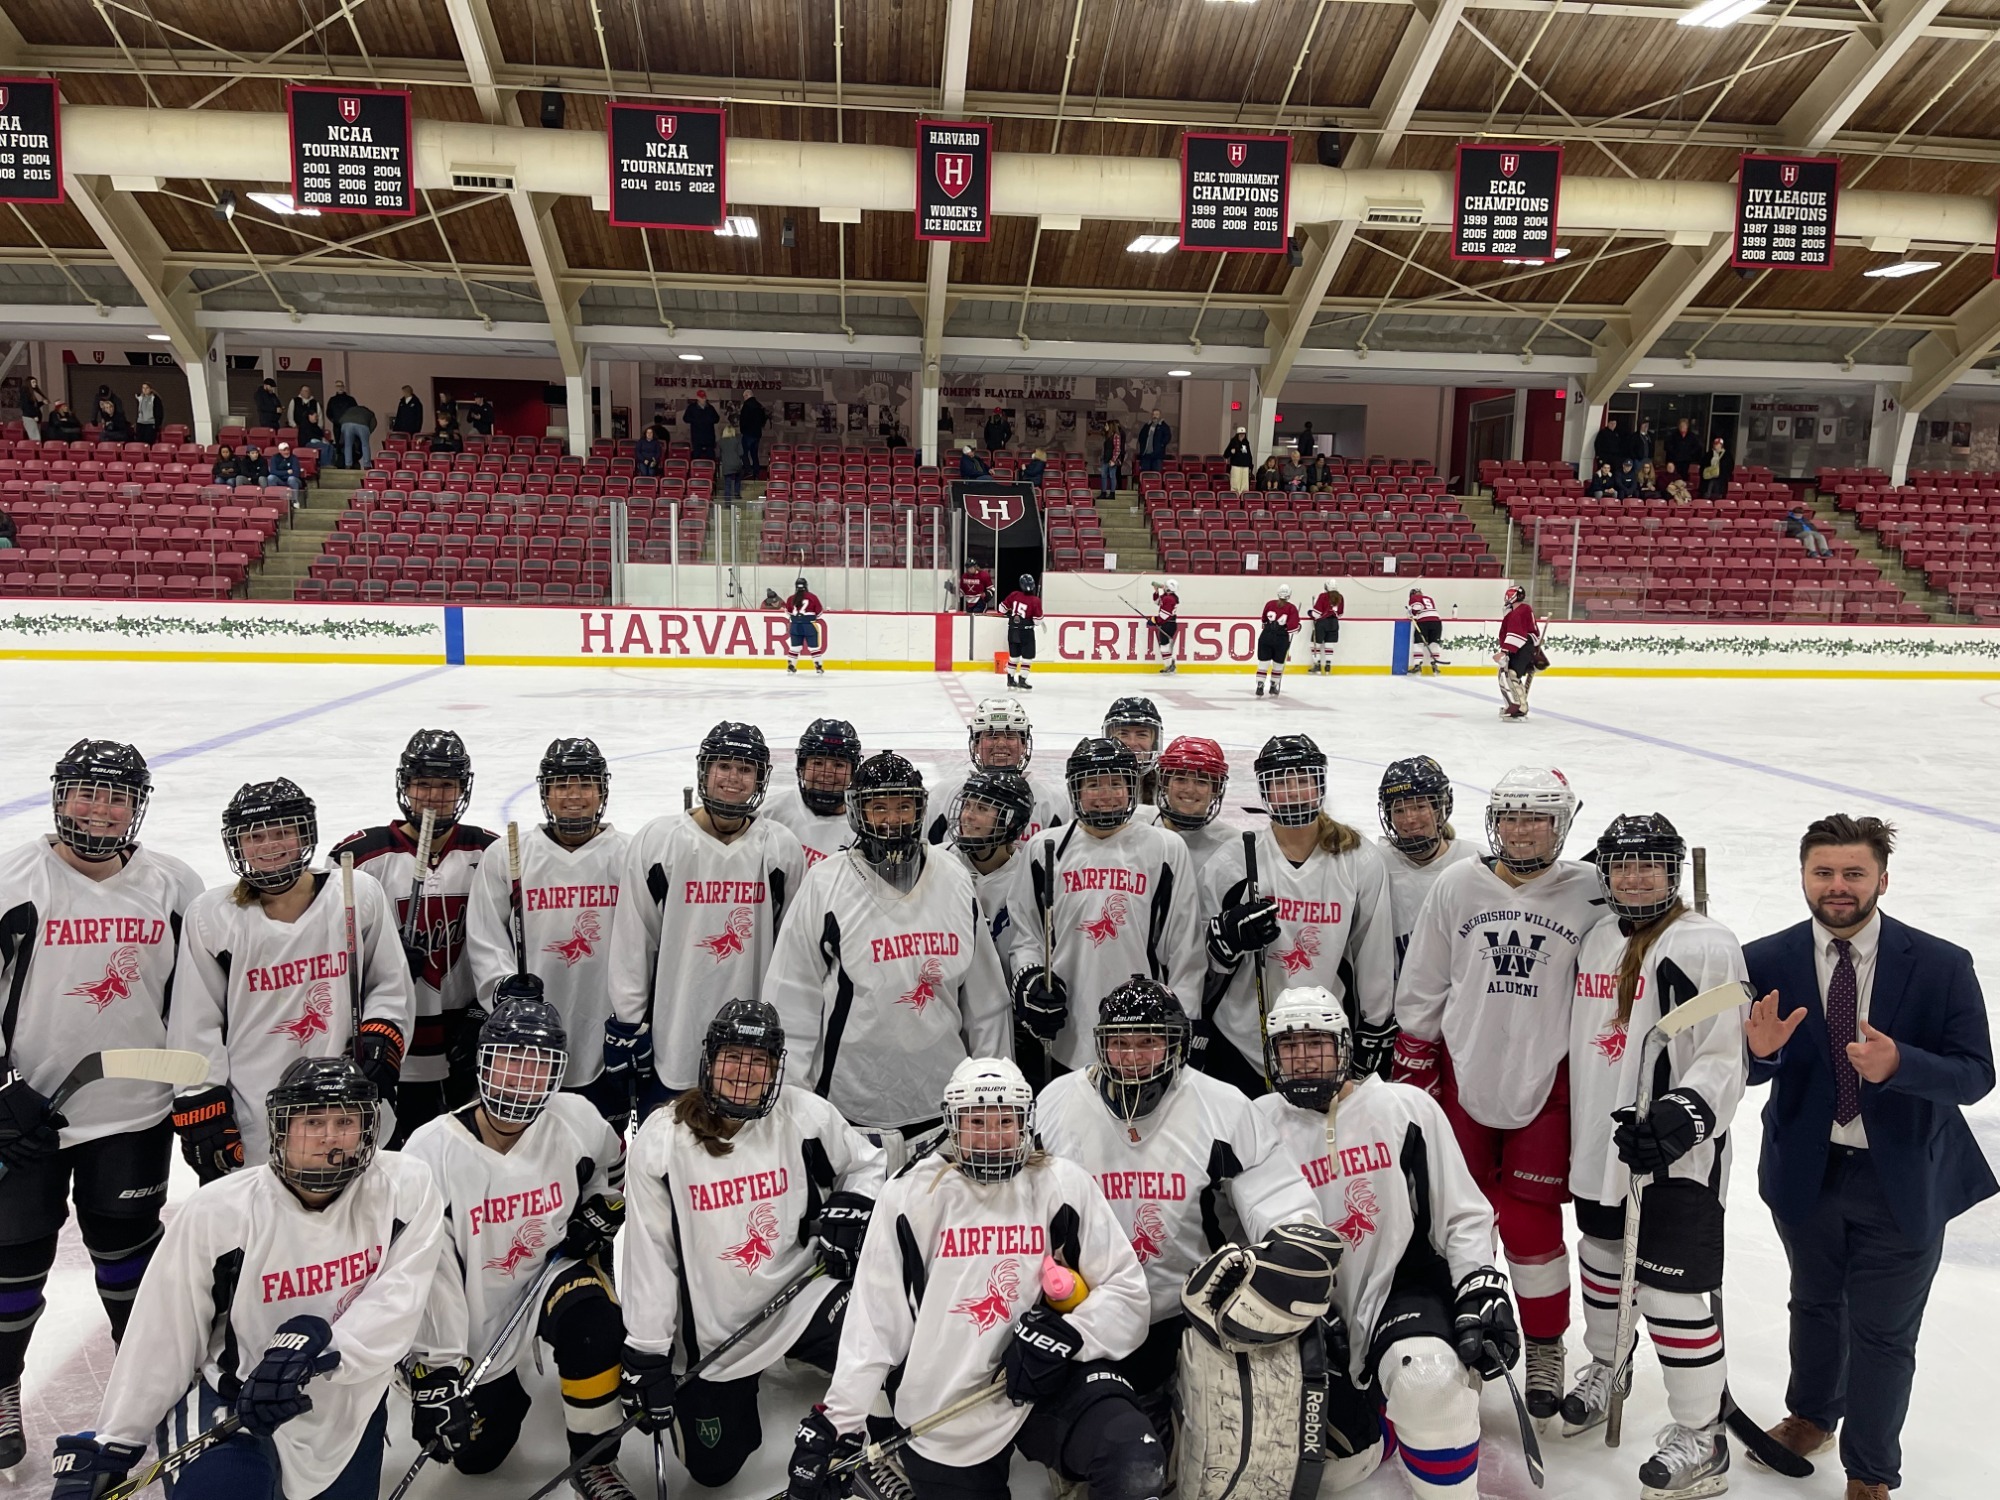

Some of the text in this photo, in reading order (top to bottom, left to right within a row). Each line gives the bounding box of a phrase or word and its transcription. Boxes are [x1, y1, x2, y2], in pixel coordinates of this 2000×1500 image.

[344, 100, 356, 116] H
[0, 116, 22, 131] AA
[661, 118, 672, 134] H
[11, 134, 49, 148] FOUR
[328, 126, 373, 142] NCAA
[930, 132, 980, 146] HARVARD
[302, 144, 400, 160] TOURNAMENT
[646, 142, 688, 159] NCAA
[1232, 146, 1242, 160] H
[0, 154, 51, 165] 03 2004
[1504, 156, 1515, 171] H
[0, 168, 52, 180] 08 2015
[303, 163, 401, 177] 2001 2003 2004
[621, 159, 714, 177] TOURNAMENT
[944, 158, 963, 185] H
[1784, 168, 1795, 182] H
[304, 178, 402, 192] 2005 2006 2007
[621, 178, 715, 193] 2014 2015 2022
[1194, 172, 1280, 185] ECAC TOURNAMENT
[1192, 186, 1279, 202] CHAMPIONS
[1490, 180, 1526, 195] ECAC
[304, 192, 402, 206] 2008 2010 2013
[1465, 196, 1550, 212] CHAMPIONS
[1748, 188, 1826, 206] IVY LEAGUE
[930, 205, 978, 218] WOMEN'S
[1192, 204, 1278, 218] 1999 2004 2005
[1745, 204, 1827, 222] CHAMPIONS
[924, 218, 982, 232] ICE HOCKEY
[1191, 218, 1278, 231] 2006 2008 2015
[1463, 215, 1548, 226] 1999 2003 2004
[1463, 228, 1548, 240] 2005 2008 2009
[1744, 223, 1826, 236] 1987 1988 1989
[1462, 242, 1516, 253] 2015 2022
[1742, 236, 1825, 248] 1999 2003 2005
[1742, 250, 1824, 262] 2008 2009 2013
[654, 377, 782, 390] MEN'S PLAYER AWARDS
[984, 389, 1024, 398] PLAYER
[1026, 390, 1070, 400] AWARDS
[1882, 398, 1894, 412] 14
[979, 500, 1010, 520] H
[580, 613, 1291, 661] HARVARD CRIMSO
[90, 767, 122, 776] BAUER
[241, 805, 272, 816] BAUER
[1063, 868, 1147, 896] FAIRFIELD
[526, 884, 619, 912] FAIRFIELD
[685, 881, 766, 904] FAIRFIELD
[1265, 896, 1342, 924] IRFIELD
[44, 917, 166, 947] FAIRFIELD
[1458, 911, 1580, 945] ARCHBISHOP WILLIAMS
[871, 932, 959, 963] FAIRFIELD
[1492, 946, 1536, 958] BISHOPS
[246, 950, 348, 993] FAIRFIELD
[1487, 982, 1538, 998] ALUMNI
[1576, 973, 1646, 1000] FAIRFD
[738, 1025, 764, 1036] COUGARS
[606, 1034, 637, 1048] CM
[974, 1085, 1006, 1093] BAUER
[1128, 1128, 1142, 1142] 1
[1514, 1169, 1563, 1186] BAUER
[689, 1168, 788, 1211] FAIRFIELD
[470, 1182, 564, 1236] FIRFIELD
[584, 1208, 619, 1233] BAU
[1287, 1226, 1322, 1238] CCM
[262, 1246, 382, 1303] FAIRFIEL
[1616, 1217, 1638, 1348] EASTON
[828, 1290, 852, 1324] BAU
[1015, 1321, 1072, 1358] AUER
[1304, 1390, 1324, 1454] Reebok
